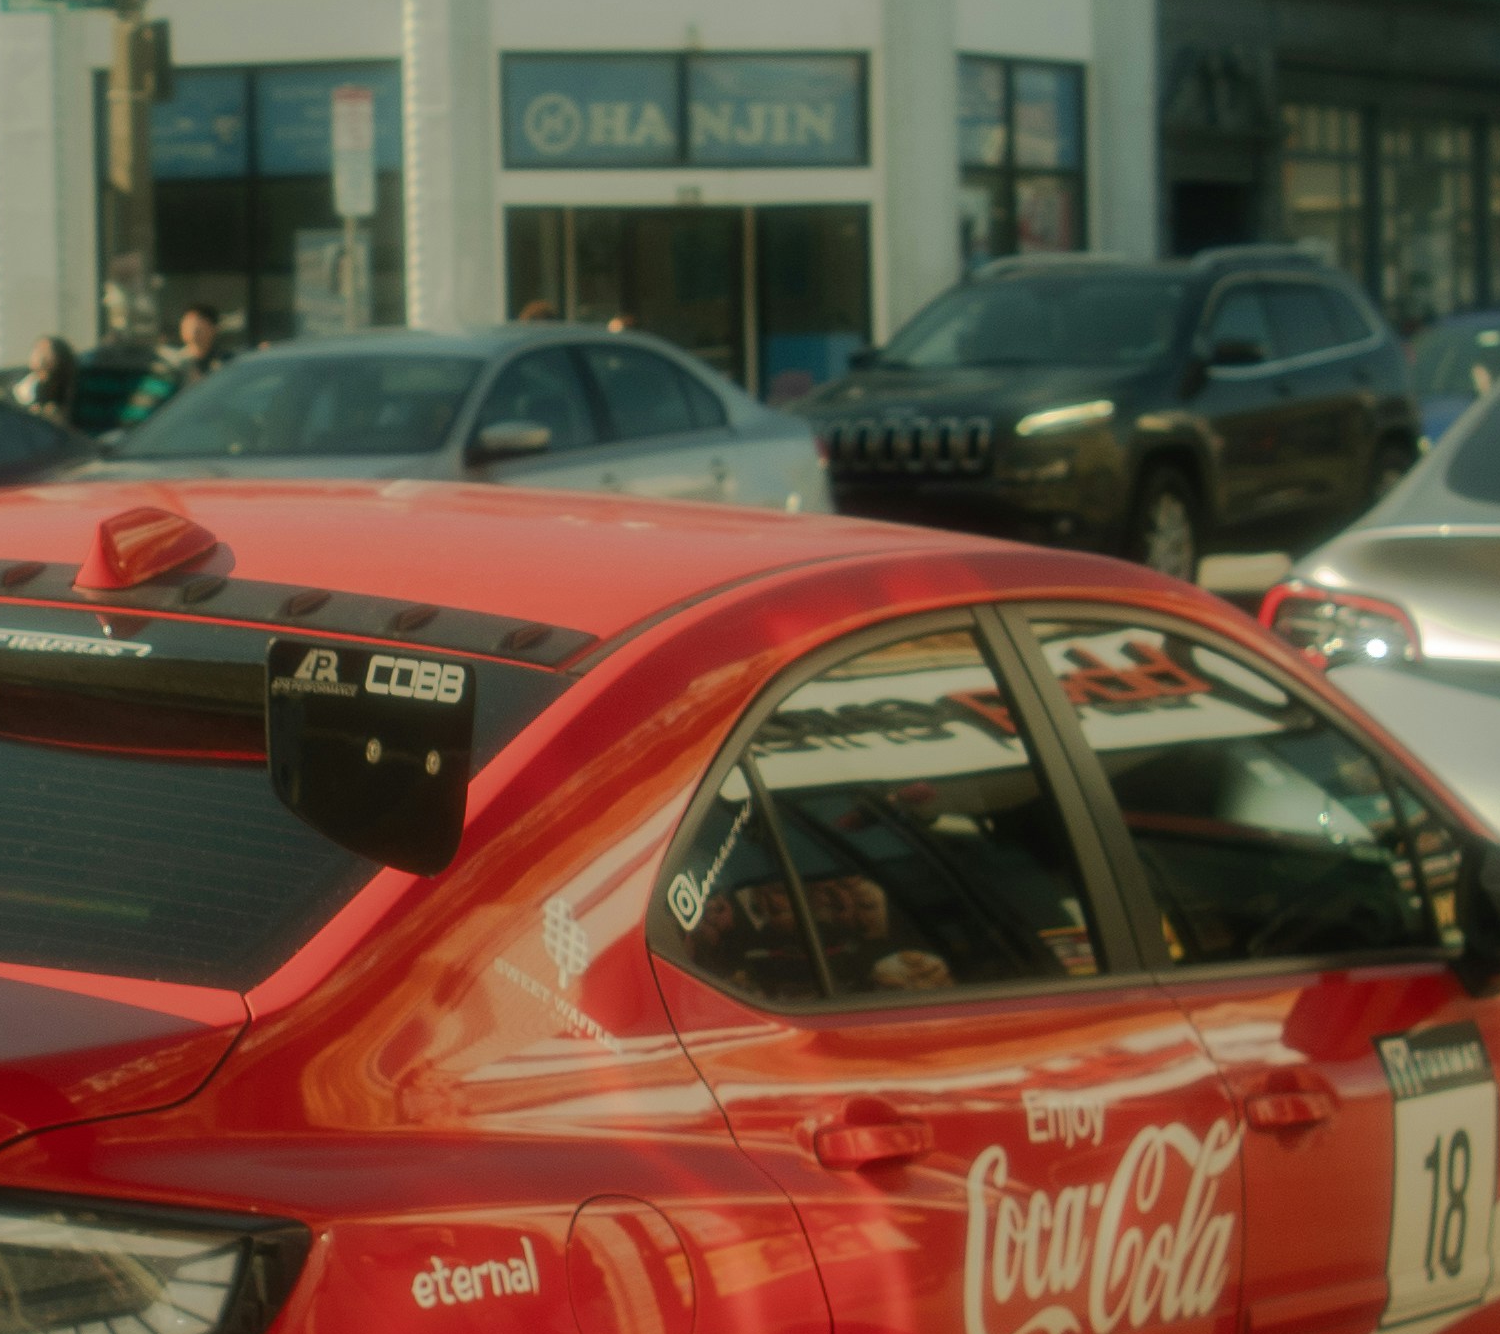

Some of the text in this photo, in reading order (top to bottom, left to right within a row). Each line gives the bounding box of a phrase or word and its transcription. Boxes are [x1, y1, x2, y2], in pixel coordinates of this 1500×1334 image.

[587, 101, 836, 147] HANJIN
[364, 654, 466, 704] COBB
[1021, 1089, 1105, 1149] Enjoy
[1423, 1127, 1471, 1283] 18
[411, 1235, 540, 1309] eternal
